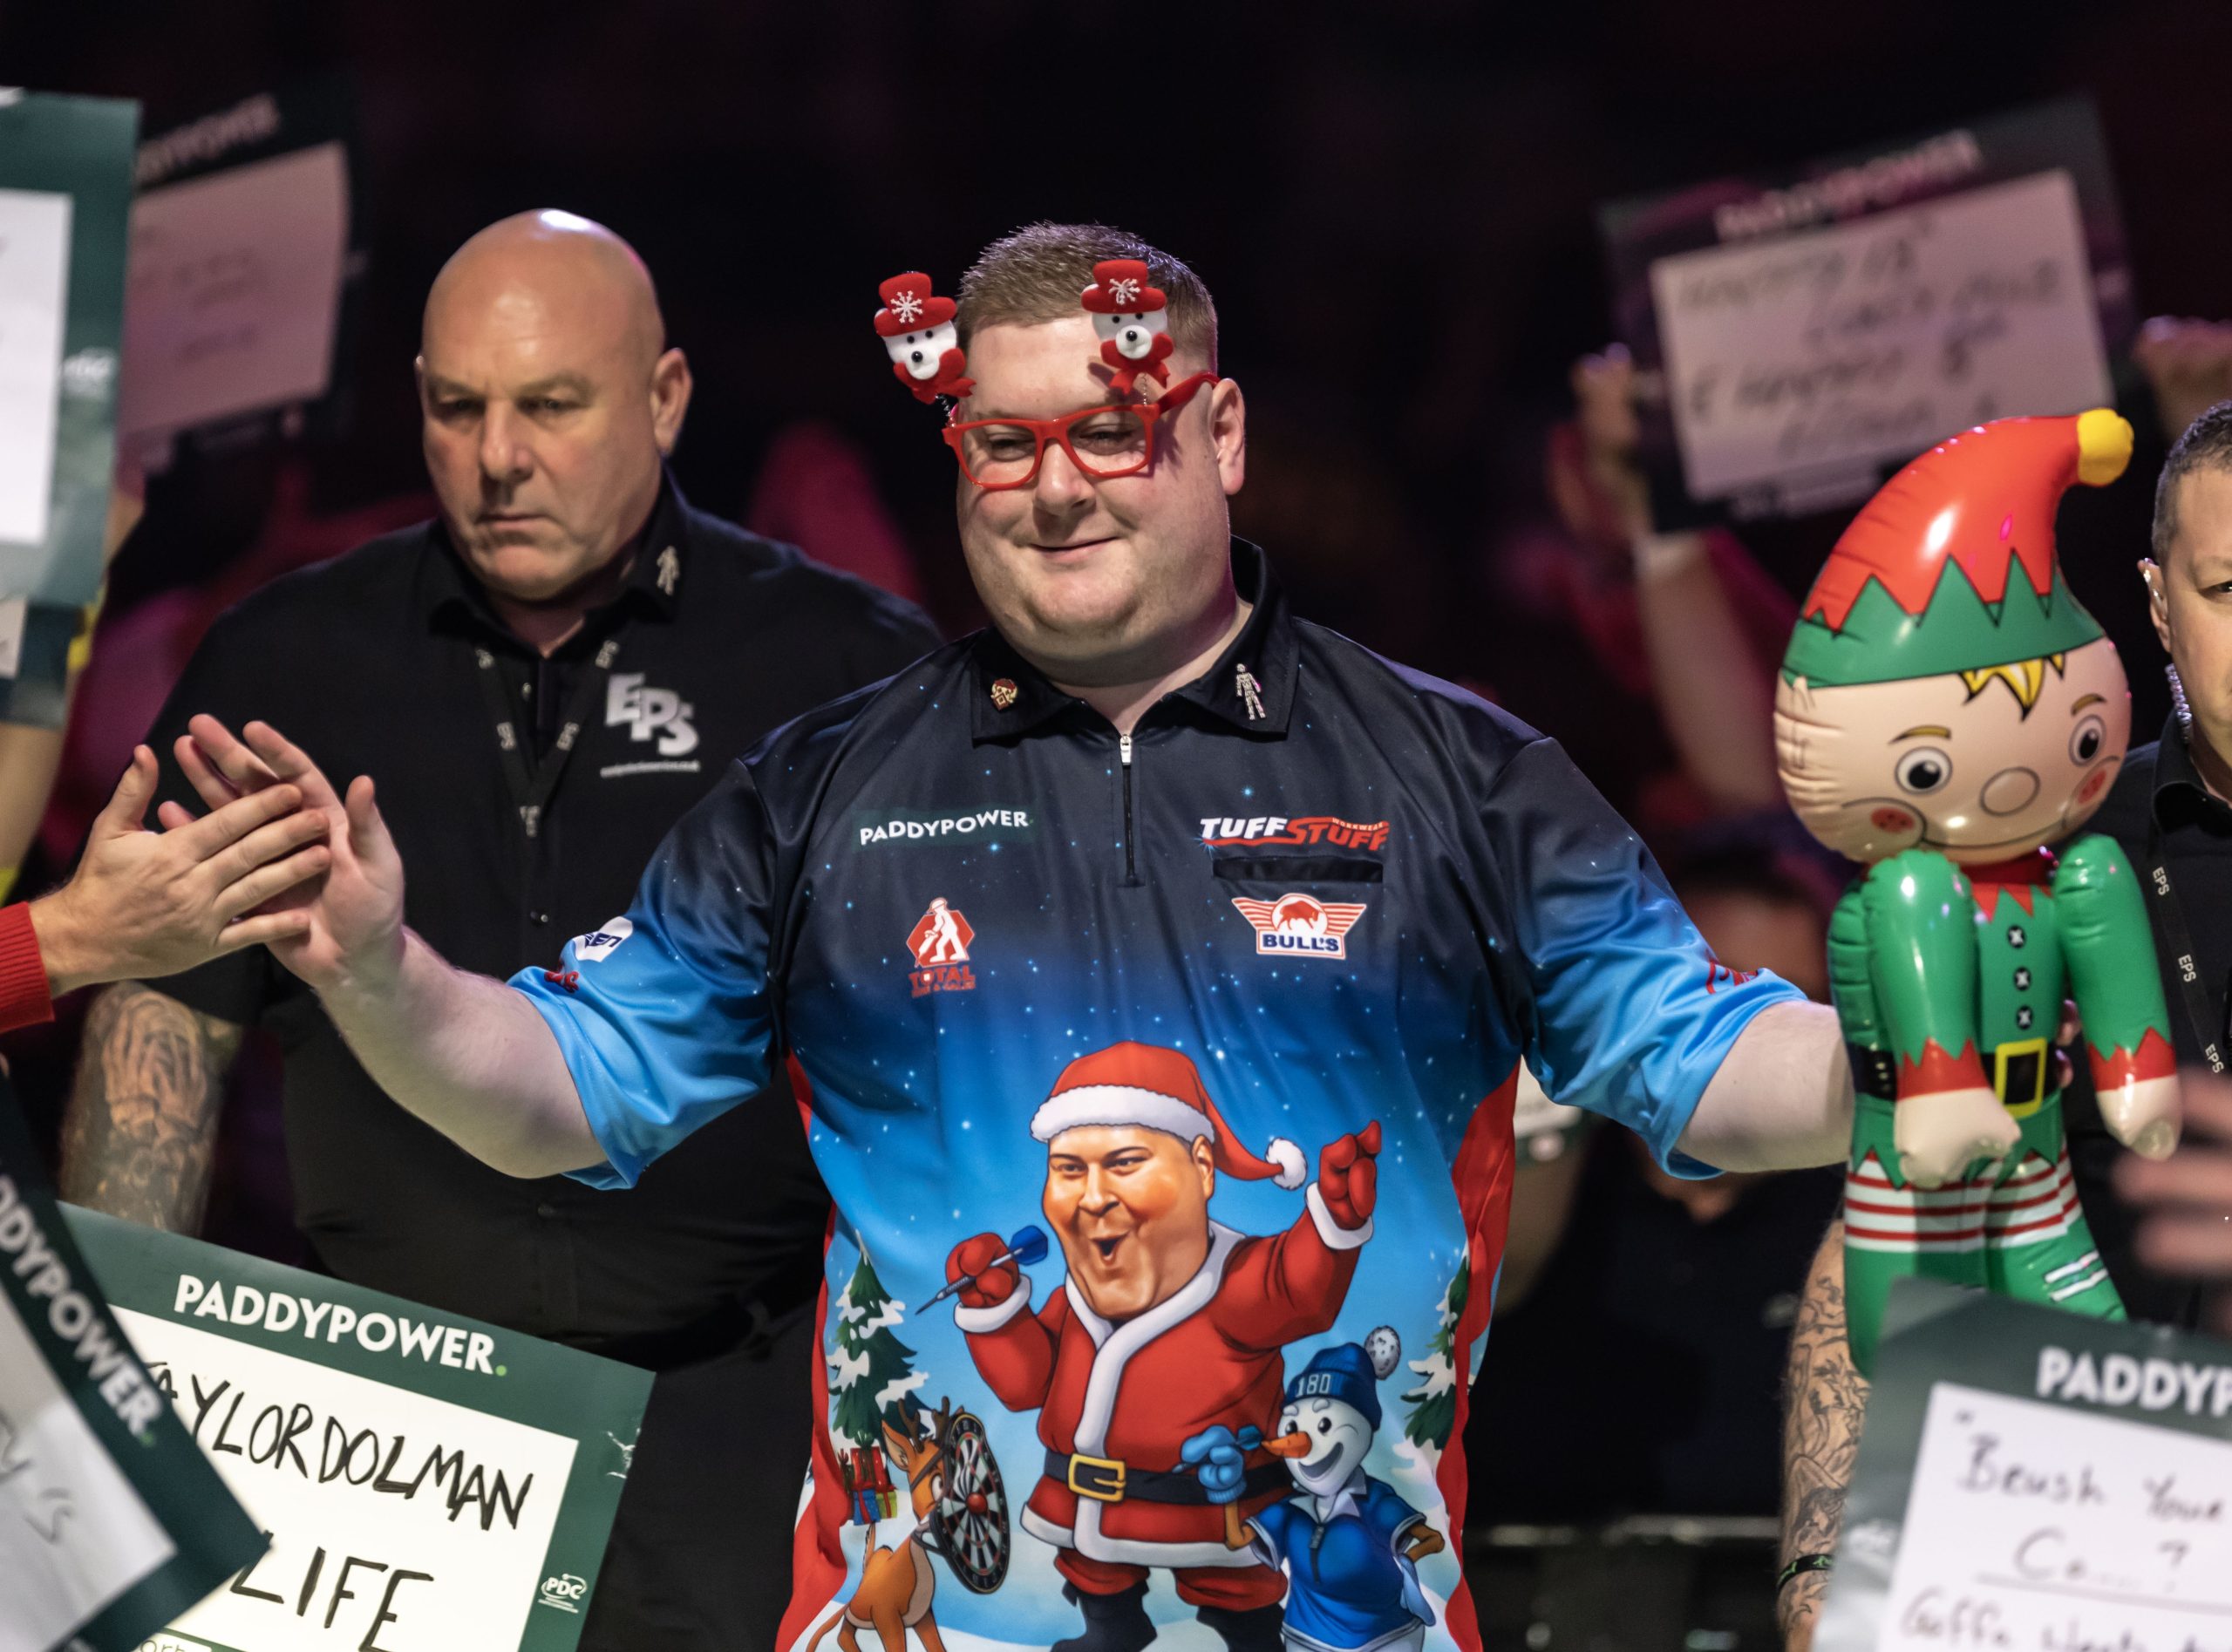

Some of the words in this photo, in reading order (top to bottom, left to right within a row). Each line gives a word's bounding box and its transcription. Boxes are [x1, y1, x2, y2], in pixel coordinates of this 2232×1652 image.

[606, 673, 699, 757] EPS
[2153, 867, 2170, 896] EPS
[1262, 934, 1340, 952] BULL'S
[2178, 955, 2196, 982] EPS
[2204, 1044, 2223, 1073] EPS
[1295, 1373, 1331, 1398] 180
[230, 1530, 434, 1652] LIFE
[546, 1576, 582, 1601] PDC
